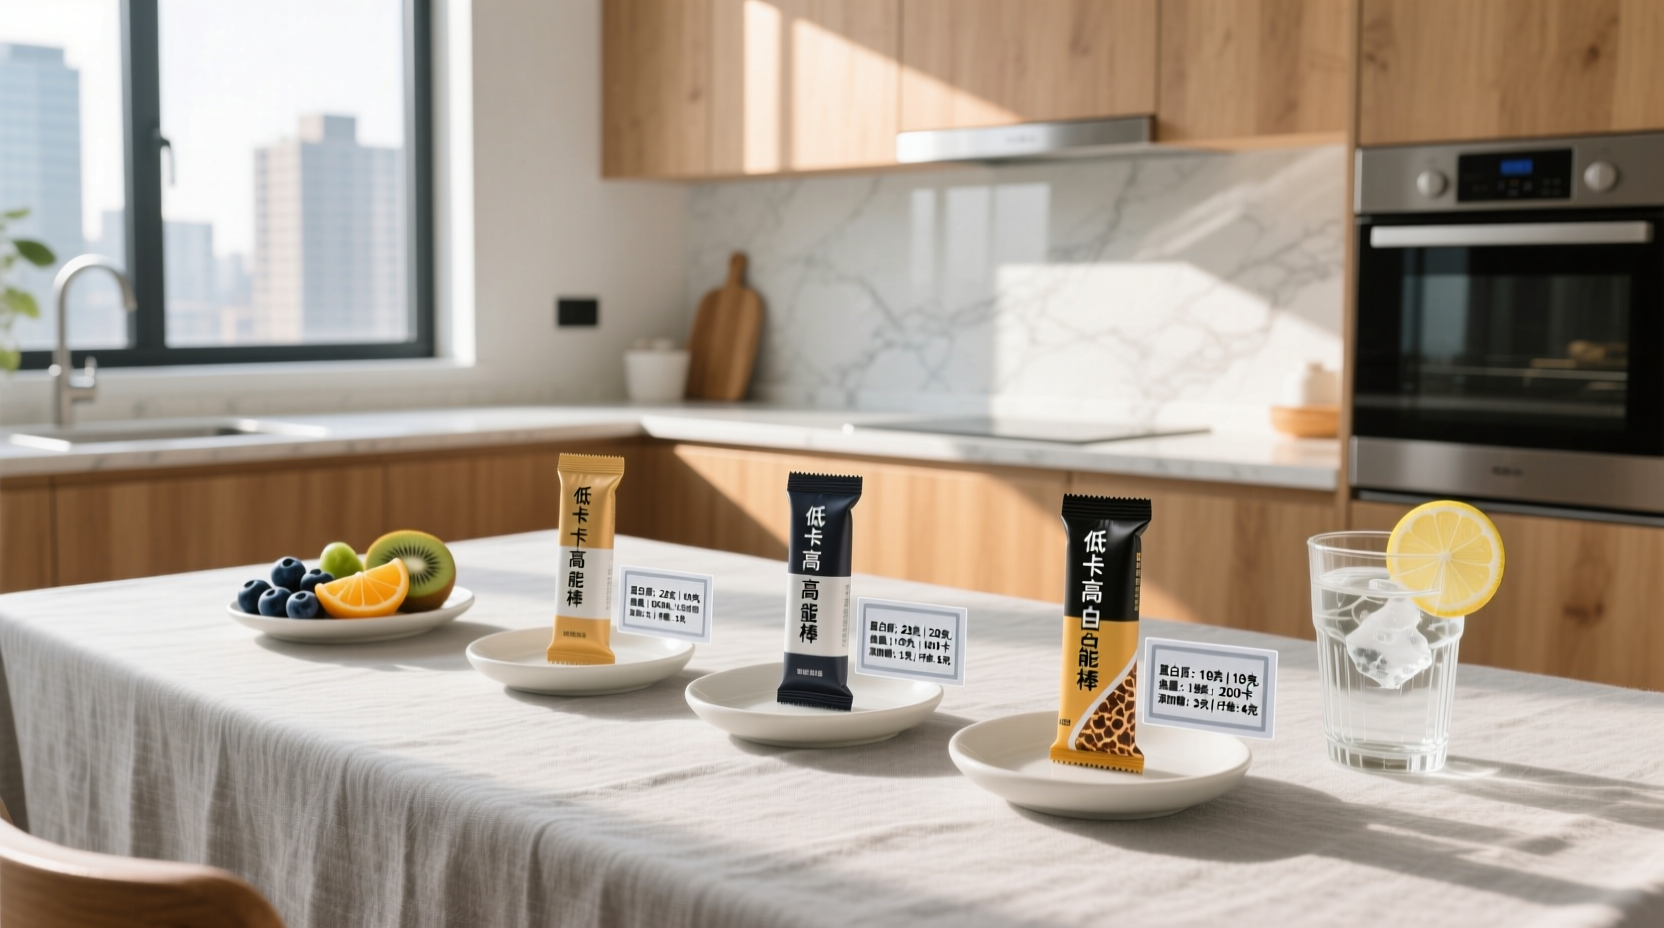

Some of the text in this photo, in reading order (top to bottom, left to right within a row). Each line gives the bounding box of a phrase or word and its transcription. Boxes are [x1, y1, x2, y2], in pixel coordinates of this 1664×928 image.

[566, 486, 592, 608] 低卡卡高能棒
